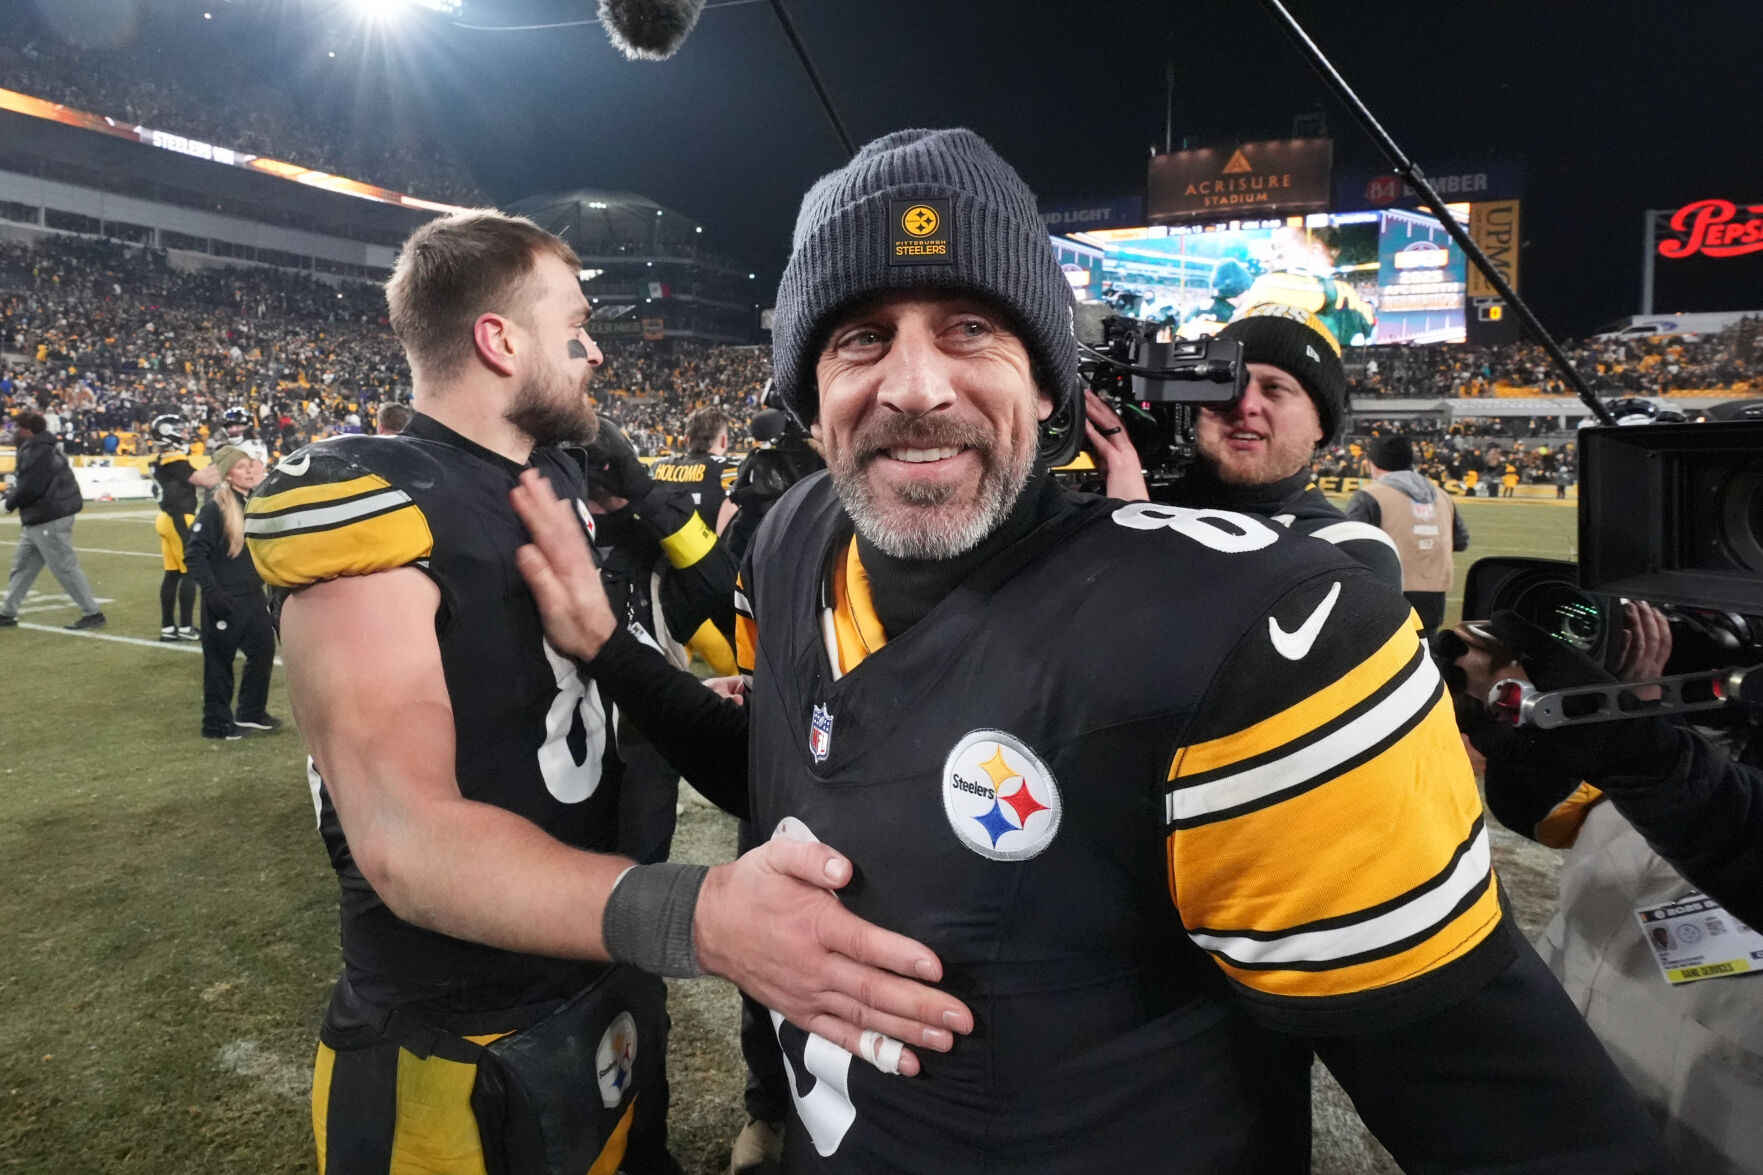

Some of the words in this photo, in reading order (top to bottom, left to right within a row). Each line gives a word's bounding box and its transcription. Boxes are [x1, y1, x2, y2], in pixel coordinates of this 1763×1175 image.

[1185, 174, 1292, 196] ACRISURE
[1403, 173, 1488, 197] LMBER
[1204, 192, 1268, 207] STADIUM
[1042, 211, 1062, 225] UD
[1063, 207, 1112, 223] LIGHT
[1658, 199, 1763, 258] PEPS
[896, 245, 947, 256] STEELERS
[655, 463, 706, 483] HOLCOMB
[1111, 502, 1279, 553] 8
[811, 727, 828, 754] NFL
[952, 773, 995, 800] Steelers
